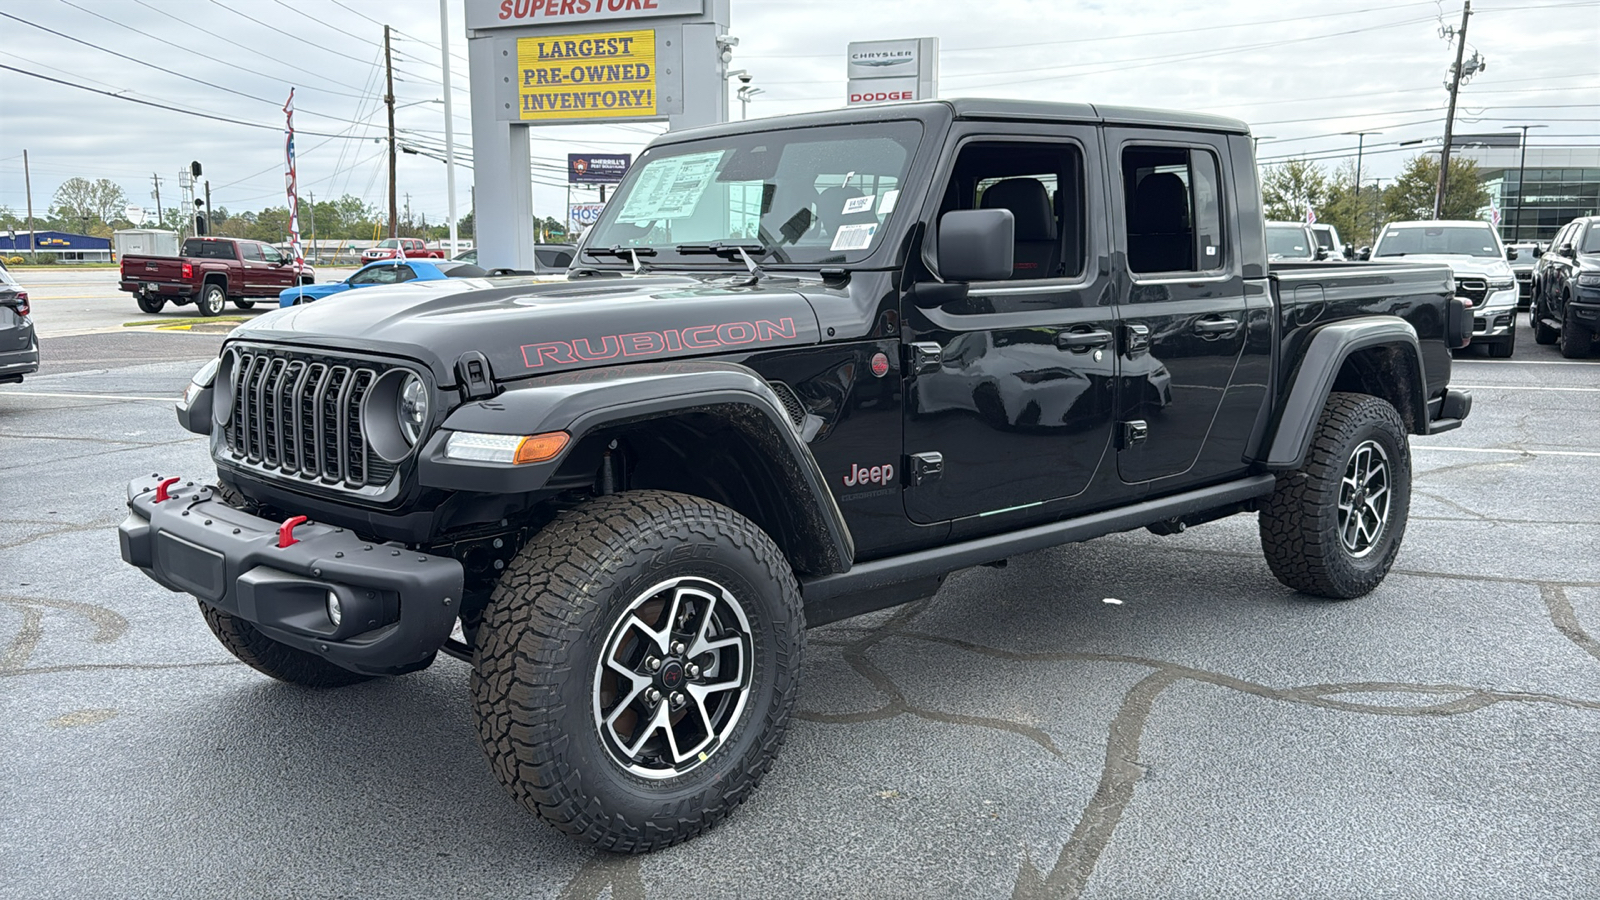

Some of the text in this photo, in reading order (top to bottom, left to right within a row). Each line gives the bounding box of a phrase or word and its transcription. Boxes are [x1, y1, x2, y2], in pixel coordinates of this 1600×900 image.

[537, 37, 634, 59] LARGEST
[852, 51, 912, 60] CHRYSLER
[522, 62, 651, 86] PRE-OWNED
[522, 88, 653, 111] INVENTORY!
[850, 91, 913, 103] DODGE
[520, 317, 797, 368] RUBICON
[843, 463, 894, 487] Jeep
[841, 488, 888, 502] GLADIATOR
[712, 619, 789, 795] WILDPEAK
